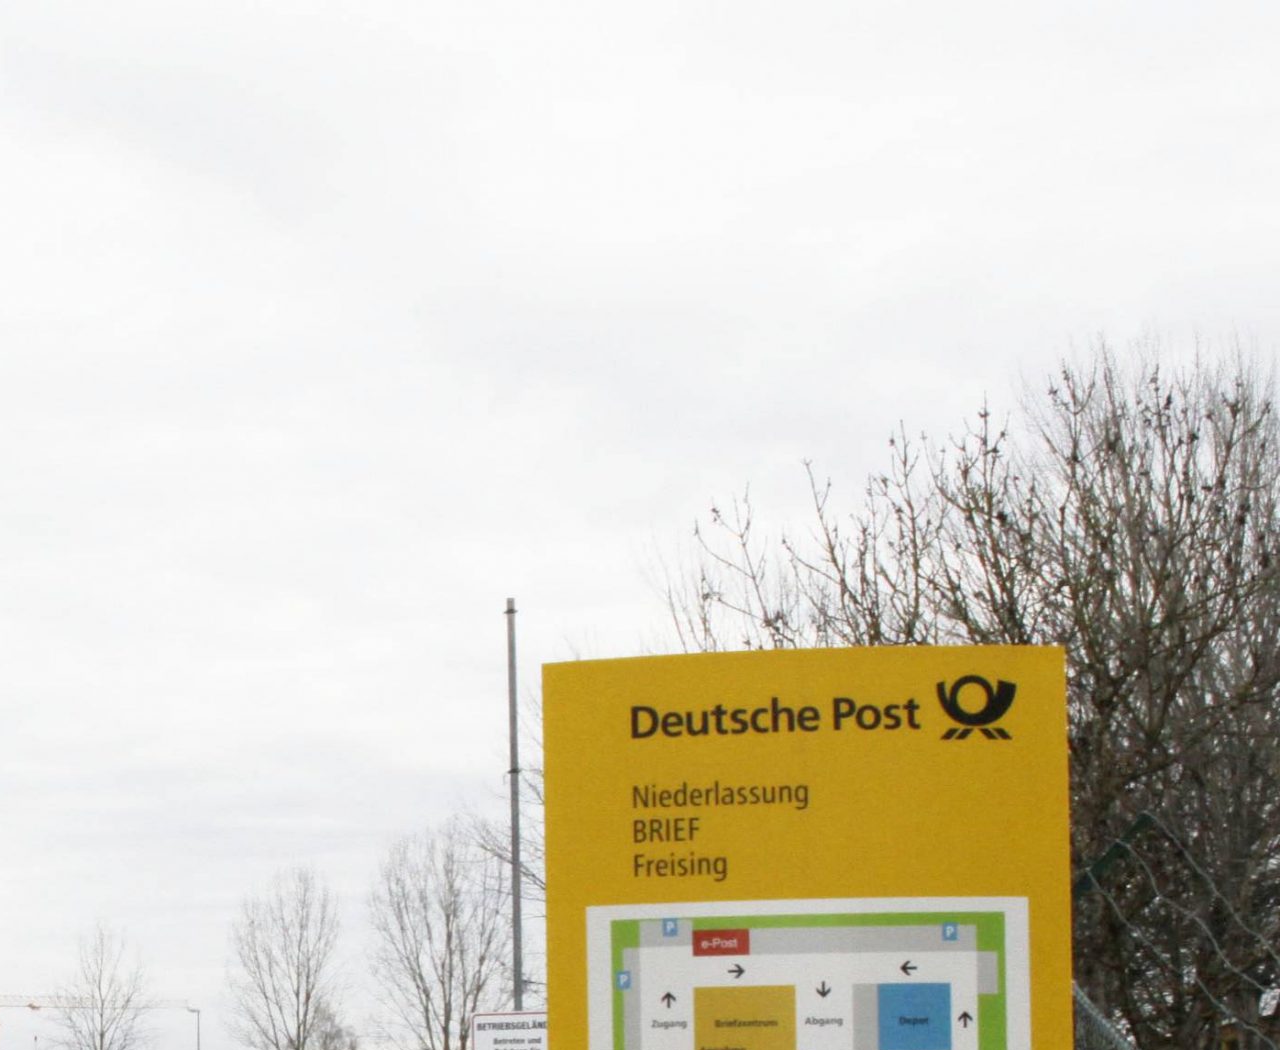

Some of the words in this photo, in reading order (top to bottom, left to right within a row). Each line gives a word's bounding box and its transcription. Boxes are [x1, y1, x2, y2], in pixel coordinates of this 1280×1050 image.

[630, 697, 821, 740] Deutsche
[832, 697, 922, 731] Post
[632, 780, 809, 811] Niederlassung
[633, 816, 701, 843] BRIEF
[632, 851, 728, 882] Freising
[700, 937, 738, 949] e-Post
[650, 1019, 688, 1029] Zugang
[714, 1018, 779, 1028] Briefzentrum
[804, 1016, 844, 1027] Abgang
[898, 1016, 930, 1027] Depot
